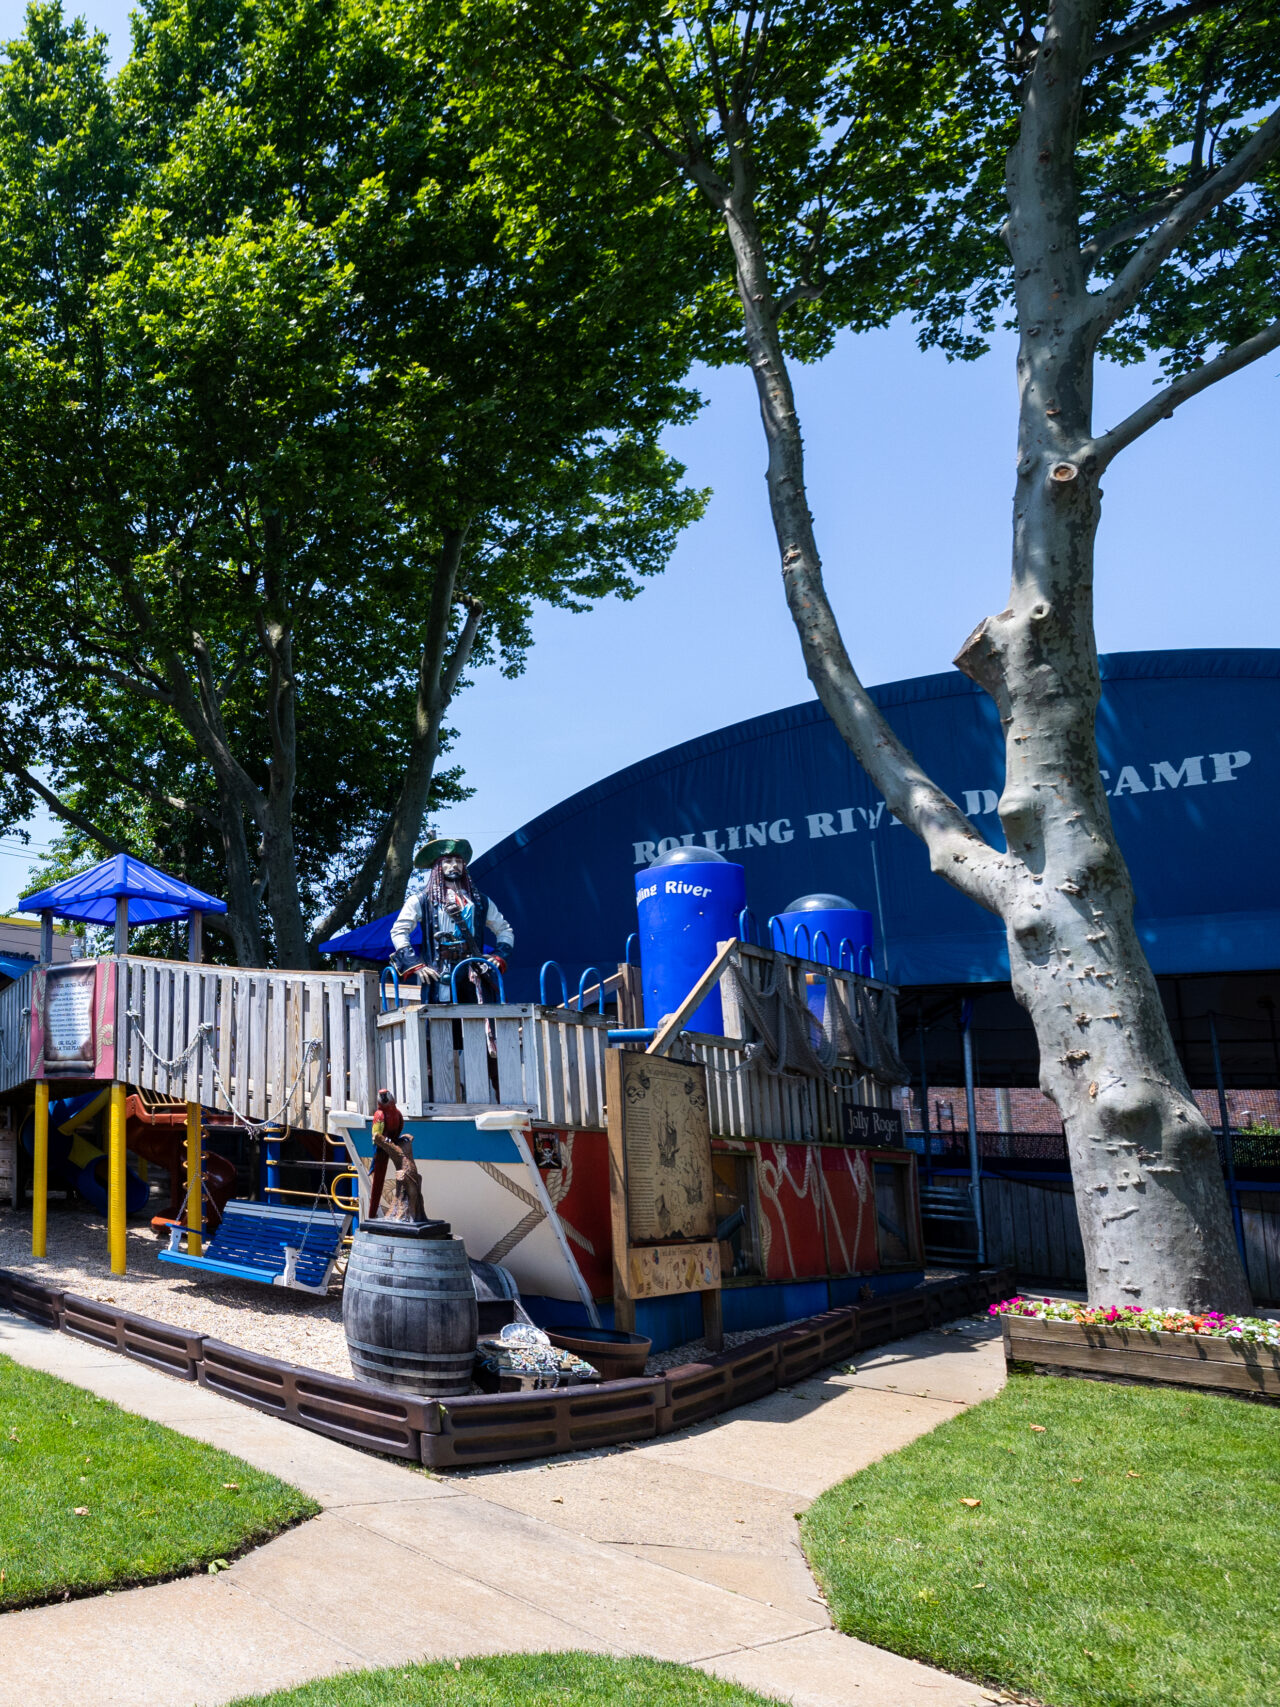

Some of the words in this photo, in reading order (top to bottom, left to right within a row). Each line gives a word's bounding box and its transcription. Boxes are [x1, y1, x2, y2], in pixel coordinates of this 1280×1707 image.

[805, 802, 903, 839] RIV
[665, 880, 713, 898] River
[848, 1108, 869, 1137] Jolly
[872, 1112, 899, 1142] Roger
